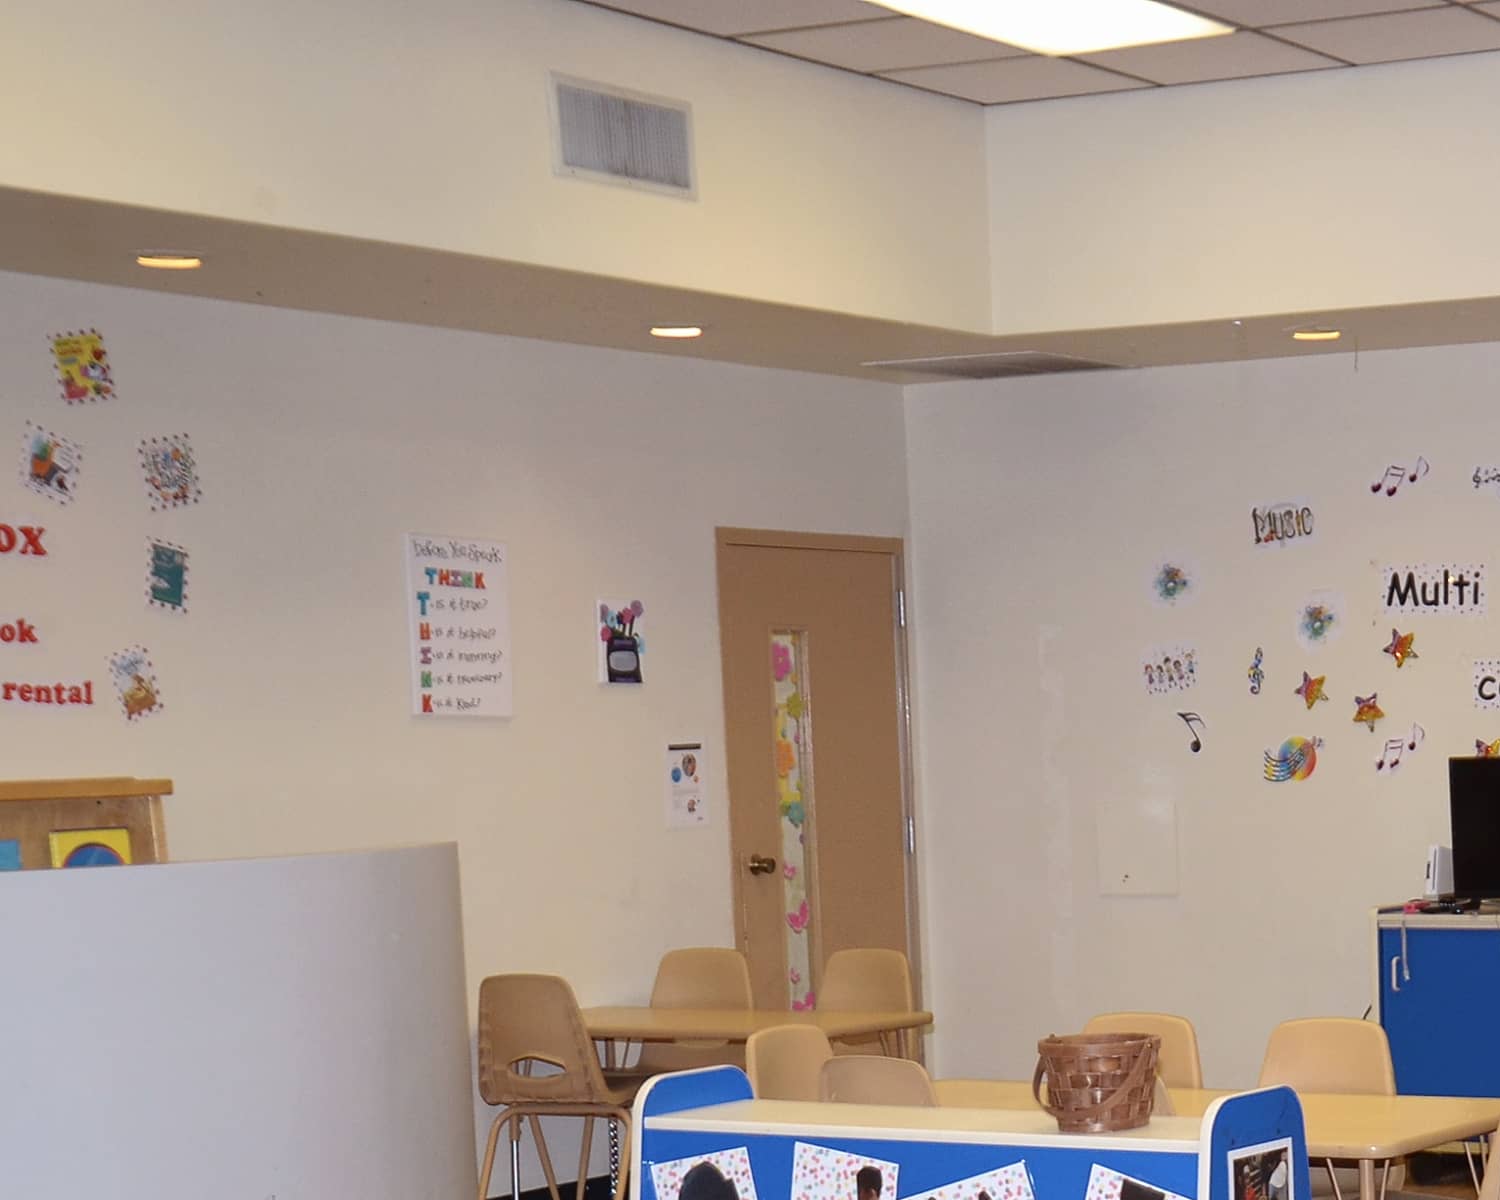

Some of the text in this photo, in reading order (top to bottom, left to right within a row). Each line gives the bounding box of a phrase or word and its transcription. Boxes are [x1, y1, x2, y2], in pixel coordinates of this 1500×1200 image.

[424, 566, 486, 590] THINK
[1386, 569, 1481, 607] Multi
[2, 679, 94, 705] rental
